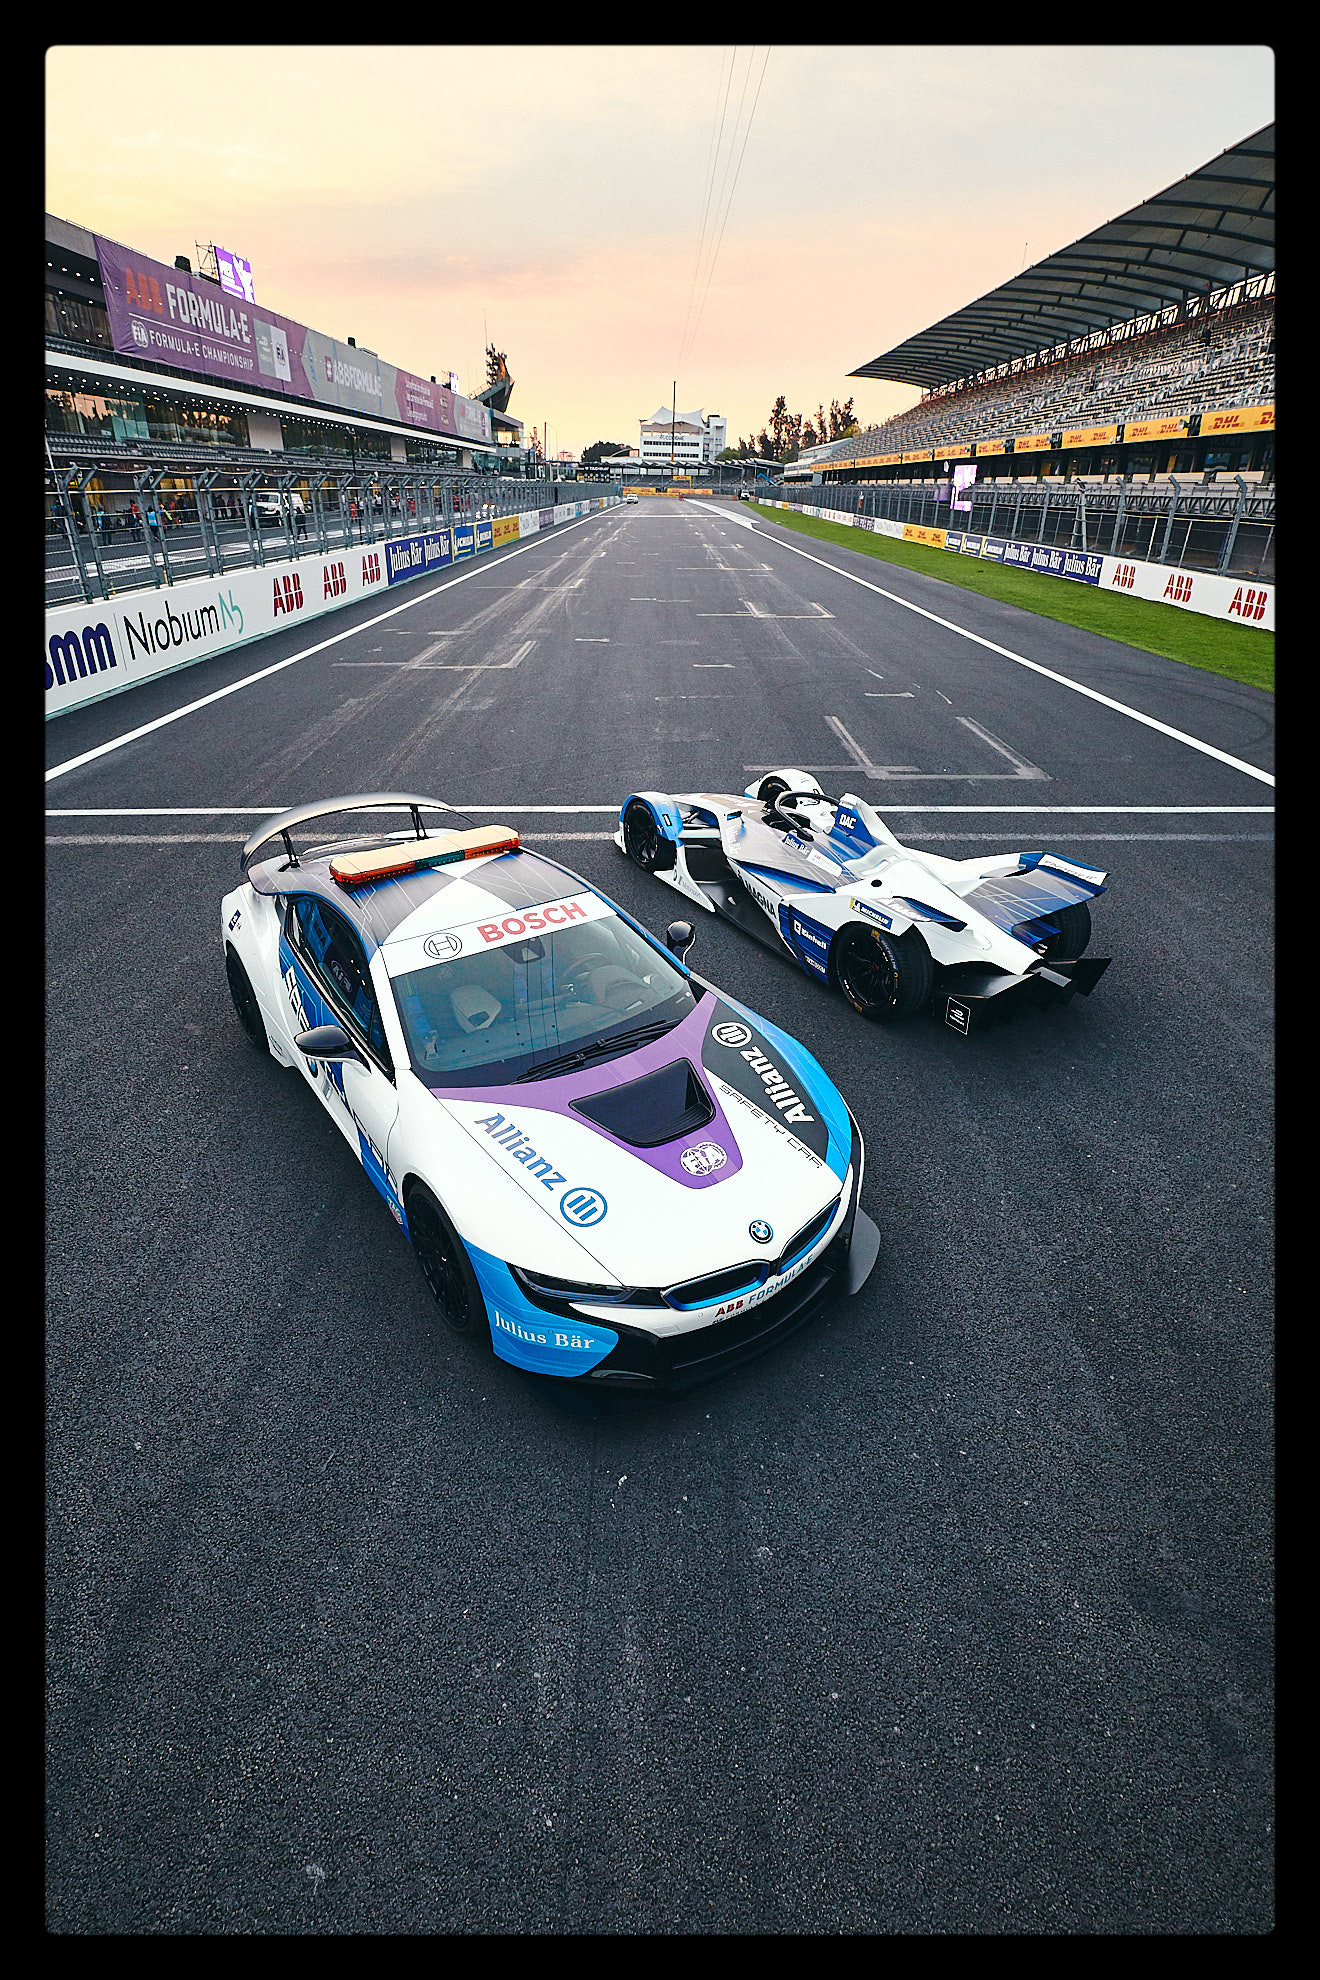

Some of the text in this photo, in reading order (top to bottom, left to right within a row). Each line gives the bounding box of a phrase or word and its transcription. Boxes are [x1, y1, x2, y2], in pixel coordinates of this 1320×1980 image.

[125, 267, 163, 314] ABB
[202, 345, 254, 371] CHAMPIONSHIP
[1131, 427, 1148, 437] DHL
[1160, 423, 1178, 434] DHL
[1213, 415, 1240, 429] DHL
[389, 542, 422, 578] Julius Bär
[424, 535, 450, 566] Julius Bär
[1003, 543, 1031, 562] Julius Bär
[1030, 548, 1062, 569] Julius Bär
[1062, 553, 1101, 577] Julius Bär
[323, 562, 347, 600] ABB
[362, 553, 381, 586] ABB
[1112, 563, 1136, 589] ABB
[273, 573, 304, 617] ABB
[1163, 574, 1193, 603] ABB
[1228, 587, 1268, 621] ABB
[123, 600, 220, 661] Niobium
[785, 835, 800, 850] Julius
[477, 902, 588, 943] BOSCH
[861, 907, 889, 925] MICHELIN
[801, 927, 827, 950] Einhell
[739, 1045, 815, 1124] Allianz
[719, 1084, 822, 1168] SAFETY CAR
[474, 1113, 567, 1191] Allianz
[715, 1299, 744, 1317] ABB
[495, 1310, 594, 1349] Julius Bär
